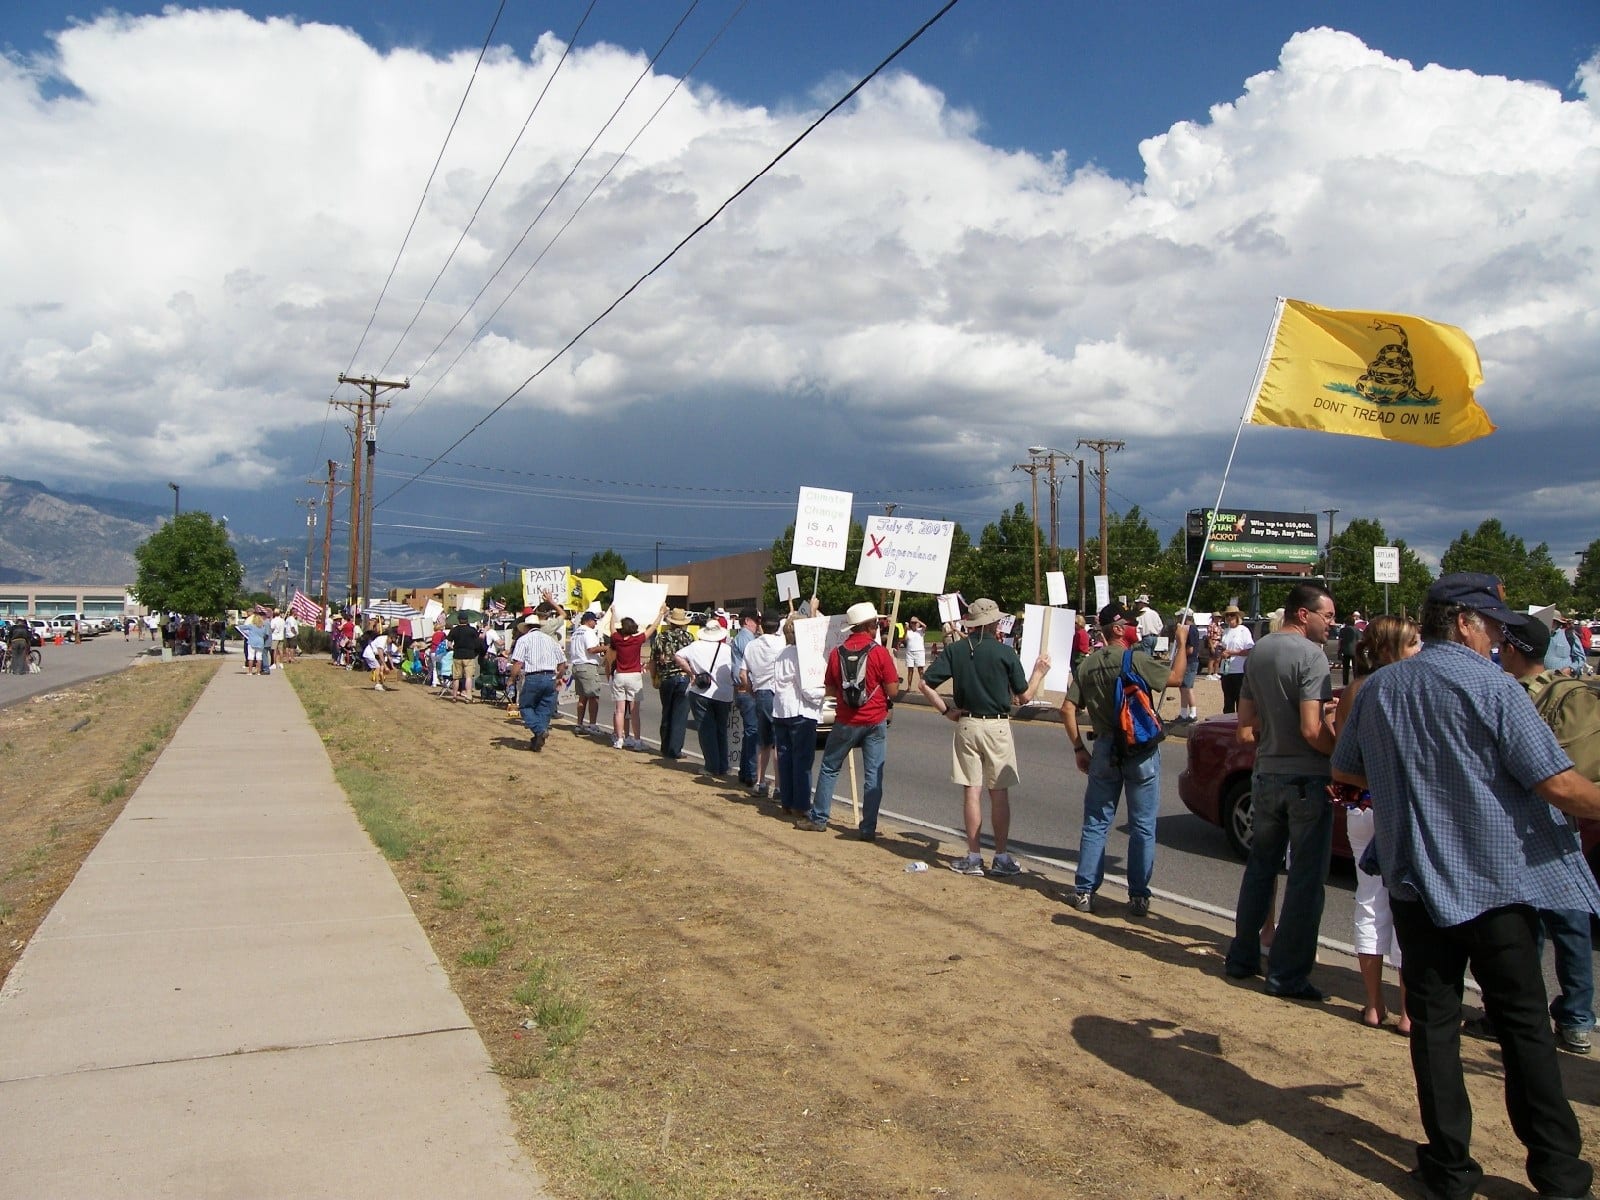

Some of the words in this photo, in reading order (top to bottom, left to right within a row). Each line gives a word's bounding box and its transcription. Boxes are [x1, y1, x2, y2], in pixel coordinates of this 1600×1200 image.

[1314, 397, 1347, 413] DONT
[1353, 407, 1395, 423] TREAD
[1401, 413, 1419, 424] ON
[1424, 412, 1440, 424] ME
[807, 491, 846, 504] Climate
[804, 506, 845, 518] Change
[825, 525, 834, 533] A
[877, 519, 902, 534] July
[1251, 528, 1264, 536] Any
[1282, 530, 1295, 538] Any
[806, 537, 838, 549] Scam
[530, 570, 566, 582] PARTY
